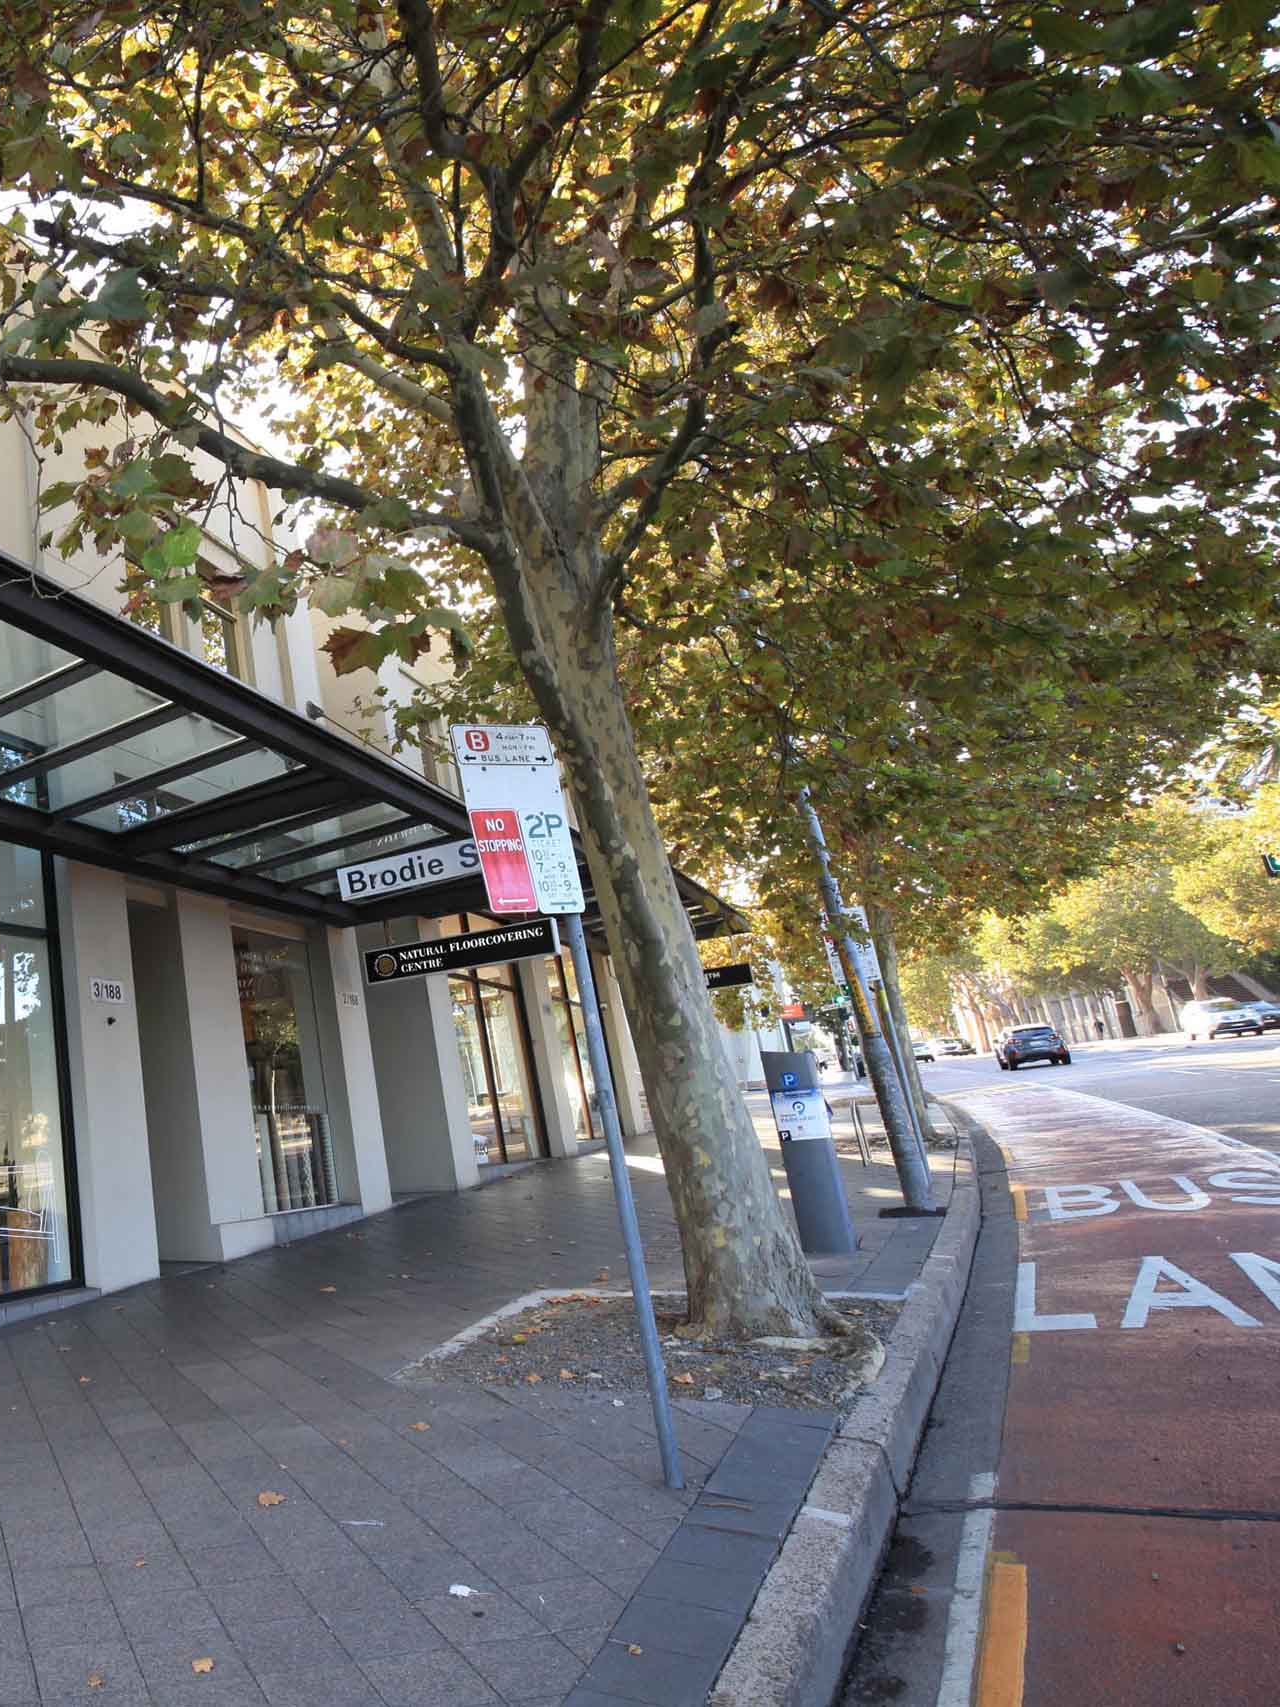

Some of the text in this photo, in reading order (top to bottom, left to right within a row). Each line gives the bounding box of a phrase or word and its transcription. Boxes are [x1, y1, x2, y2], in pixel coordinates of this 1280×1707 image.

[470, 731, 486, 751] B
[480, 754, 531, 762] BUS LANE
[485, 818, 505, 832] NO
[524, 814, 563, 838] 2P
[478, 838, 522, 853] STOPPING
[347, 855, 444, 894] Brodie
[399, 927, 544, 961] NATURAL FLOORCOVERING
[401, 957, 443, 973] CENTRE
[93, 982, 122, 1000] 3/188
[1043, 1171, 1280, 1220] BUS
